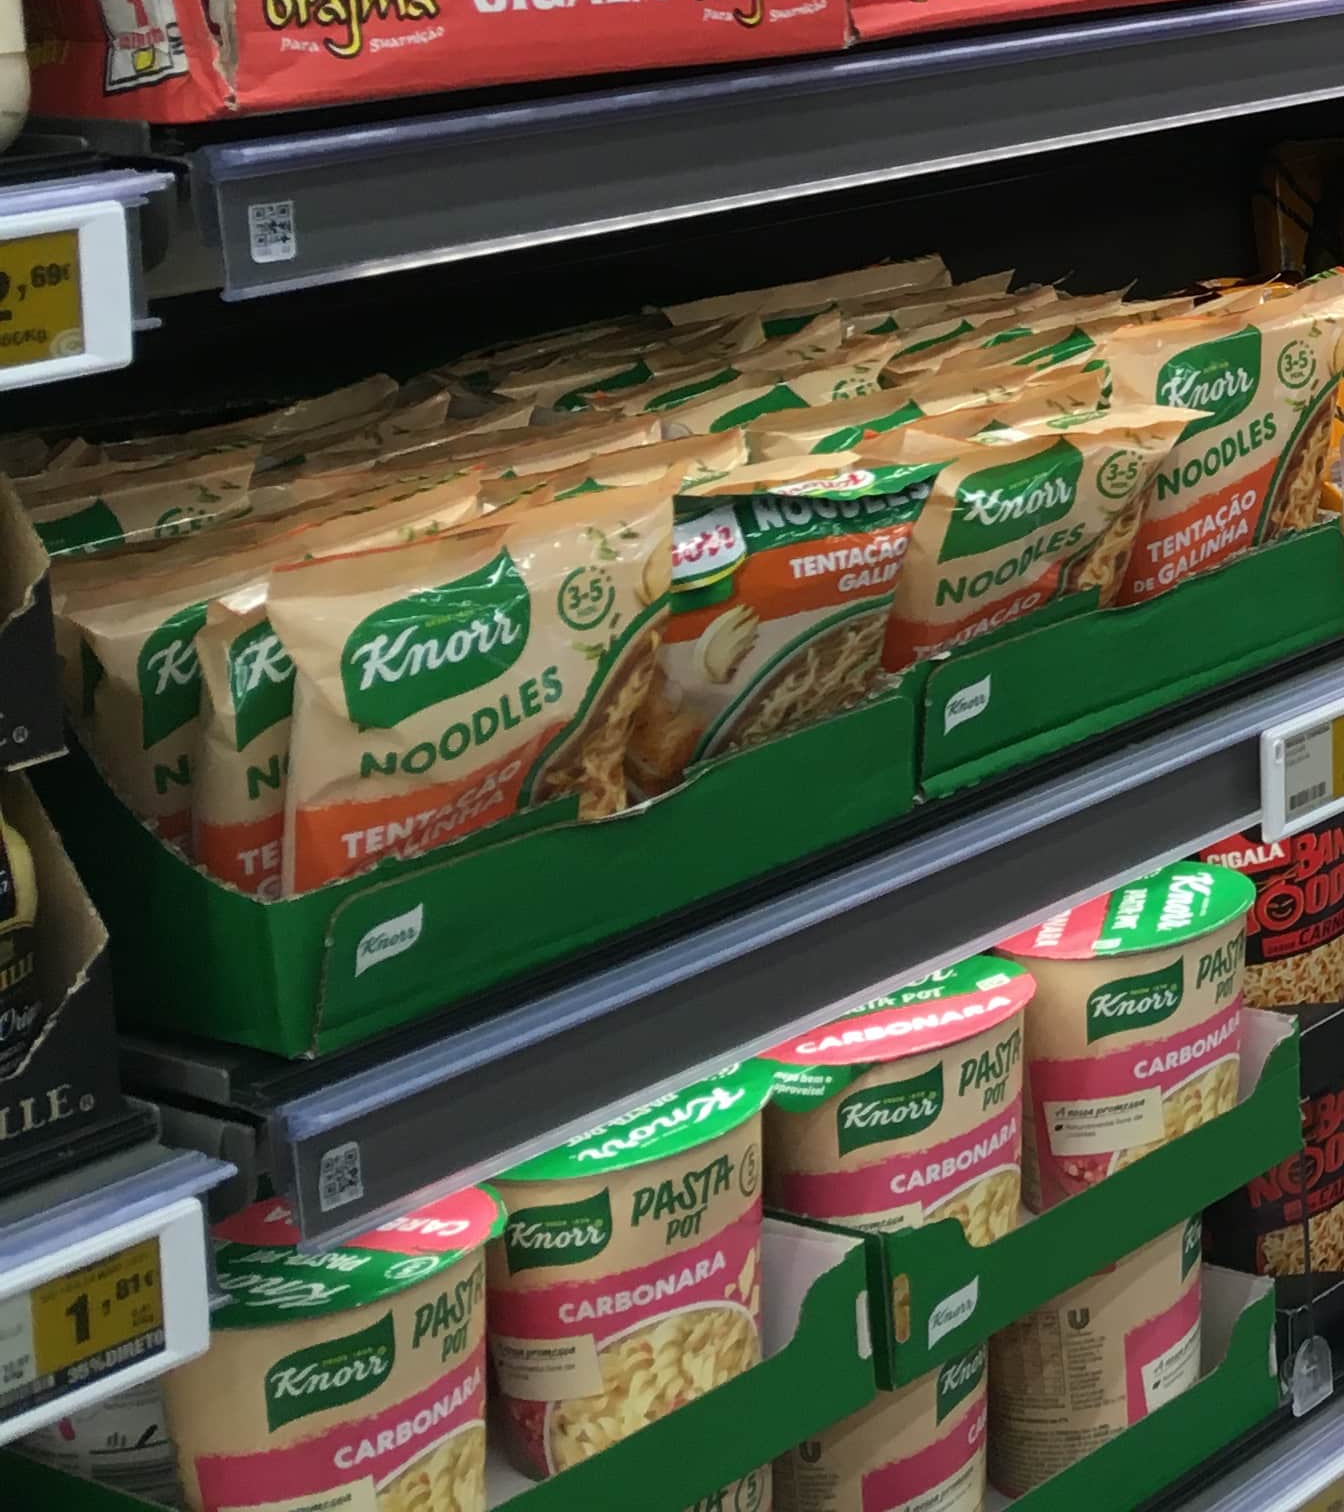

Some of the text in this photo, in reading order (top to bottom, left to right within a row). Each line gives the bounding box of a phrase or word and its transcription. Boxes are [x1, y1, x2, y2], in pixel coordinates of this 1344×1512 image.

[1161, 365, 1254, 409] Knorr
[1284, 357, 1309, 373] 3-5
[1109, 463, 1138, 481] 3-5
[1156, 414, 1277, 499] NOODLES
[964, 479, 1073, 524] Knorr
[1147, 491, 1256, 561] TENTAÇÃO
[936, 523, 1085, 607] NOODLES
[1158, 521, 1248, 587] GALINHA
[568, 582, 605, 609] 3-5
[352, 613, 521, 689] Knorr
[360, 667, 563, 780] NOODLES
[360, 925, 417, 950] Knorr
[796, 996, 1011, 1053] CARBONARA
[1092, 986, 1177, 1016] Knorr
[1134, 1016, 1240, 1079] CARBONARA
[843, 1090, 936, 1125] Knorr
[890, 1116, 1017, 1193] CARBONARA
[631, 1157, 733, 1226] PASTA
[507, 1221, 605, 1249] Knorr
[666, 1211, 701, 1243] POT
[559, 1253, 726, 1324] CARBONARA
[442, 1324, 469, 1360] POT
[270, 1356, 389, 1395] Knorr
[334, 1372, 480, 1468] CARBONARA
